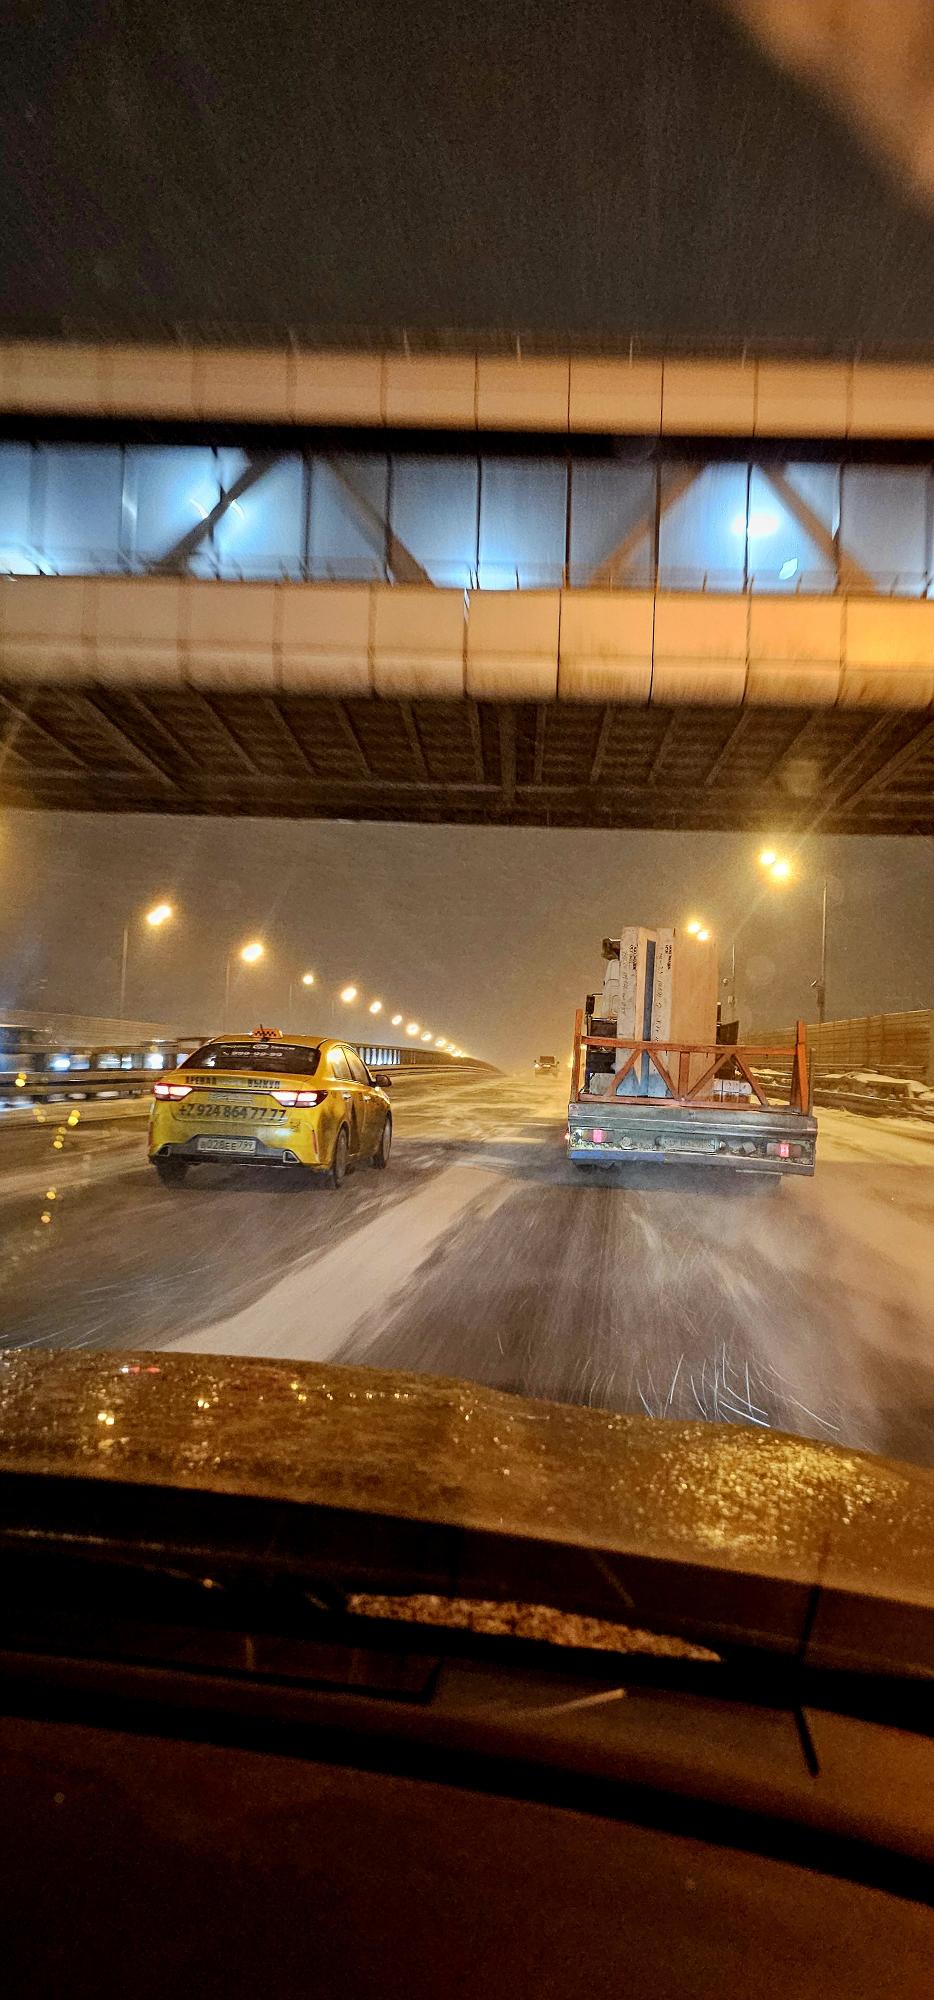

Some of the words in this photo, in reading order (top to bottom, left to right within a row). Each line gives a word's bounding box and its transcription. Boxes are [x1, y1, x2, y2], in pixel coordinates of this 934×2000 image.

[179, 1103, 194, 1116] +7
[223, 1105, 248, 1119] 864
[251, 1107, 267, 1120] 77
[270, 1108, 287, 1121] 77
